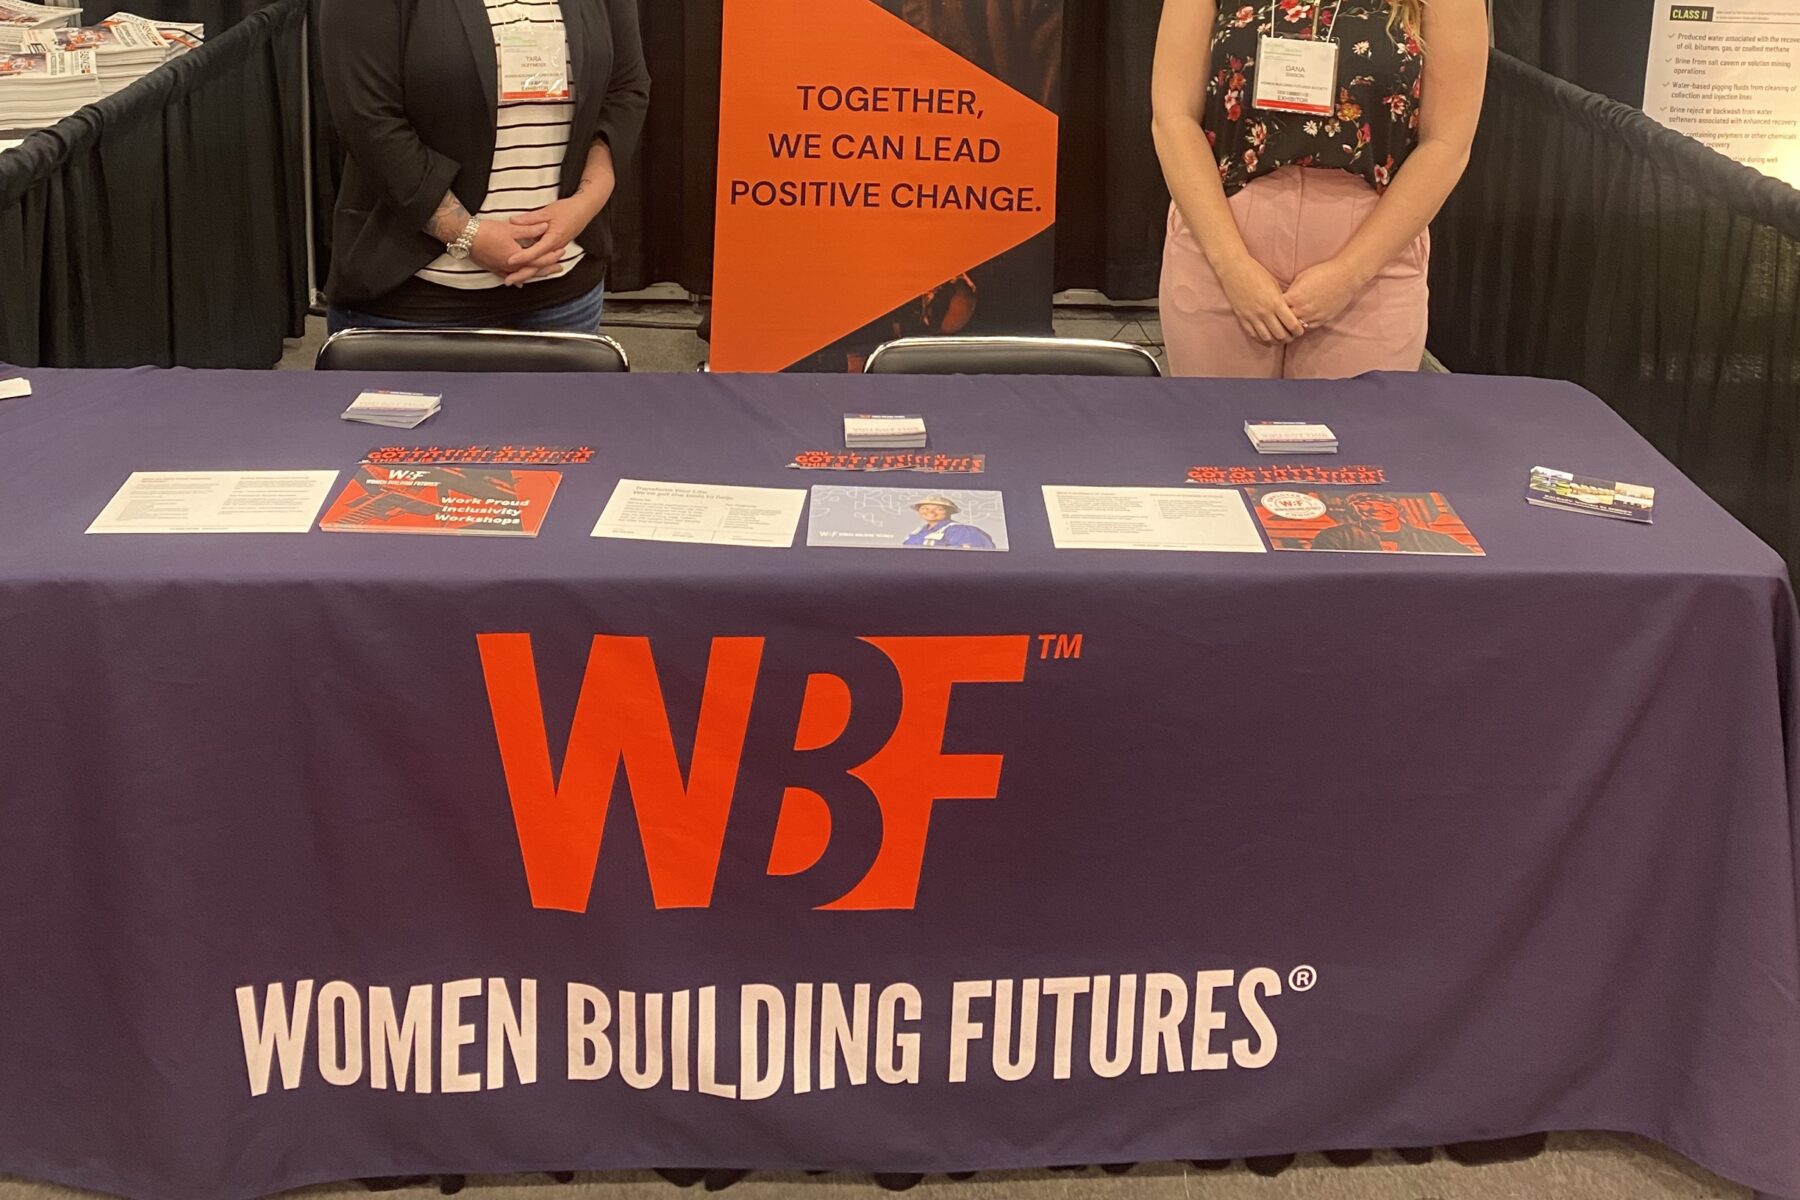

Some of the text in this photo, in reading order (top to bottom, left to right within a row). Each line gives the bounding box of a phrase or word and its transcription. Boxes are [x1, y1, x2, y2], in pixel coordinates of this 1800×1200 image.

[1672, 9, 1700, 20] CLASS
[1678, 33, 1706, 41] Produced
[1725, 35, 1756, 43] associated
[1769, 35, 1779, 43] the
[1765, 45, 1790, 53] methane
[1708, 58, 1718, 66] salt
[1285, 65, 1305, 73] DANA
[1673, 67, 1706, 76] operations
[1672, 82, 1710, 90] Water-based
[1671, 91, 1699, 99] collection
[1700, 92, 1713, 100] and
[796, 85, 985, 119] TOGETHER,
[768, 133, 1001, 163] WE CAN LEAD
[730, 180, 1042, 212] POSITIVE CHANGE.
[441, 496, 529, 507] Work Proud
[442, 506, 522, 517] Inclusivity
[434, 513, 521, 525] Workshops
[476, 633, 1030, 913] WBF
[236, 977, 539, 1098] WOMEN
[567, 981, 923, 1101] BUILDING
